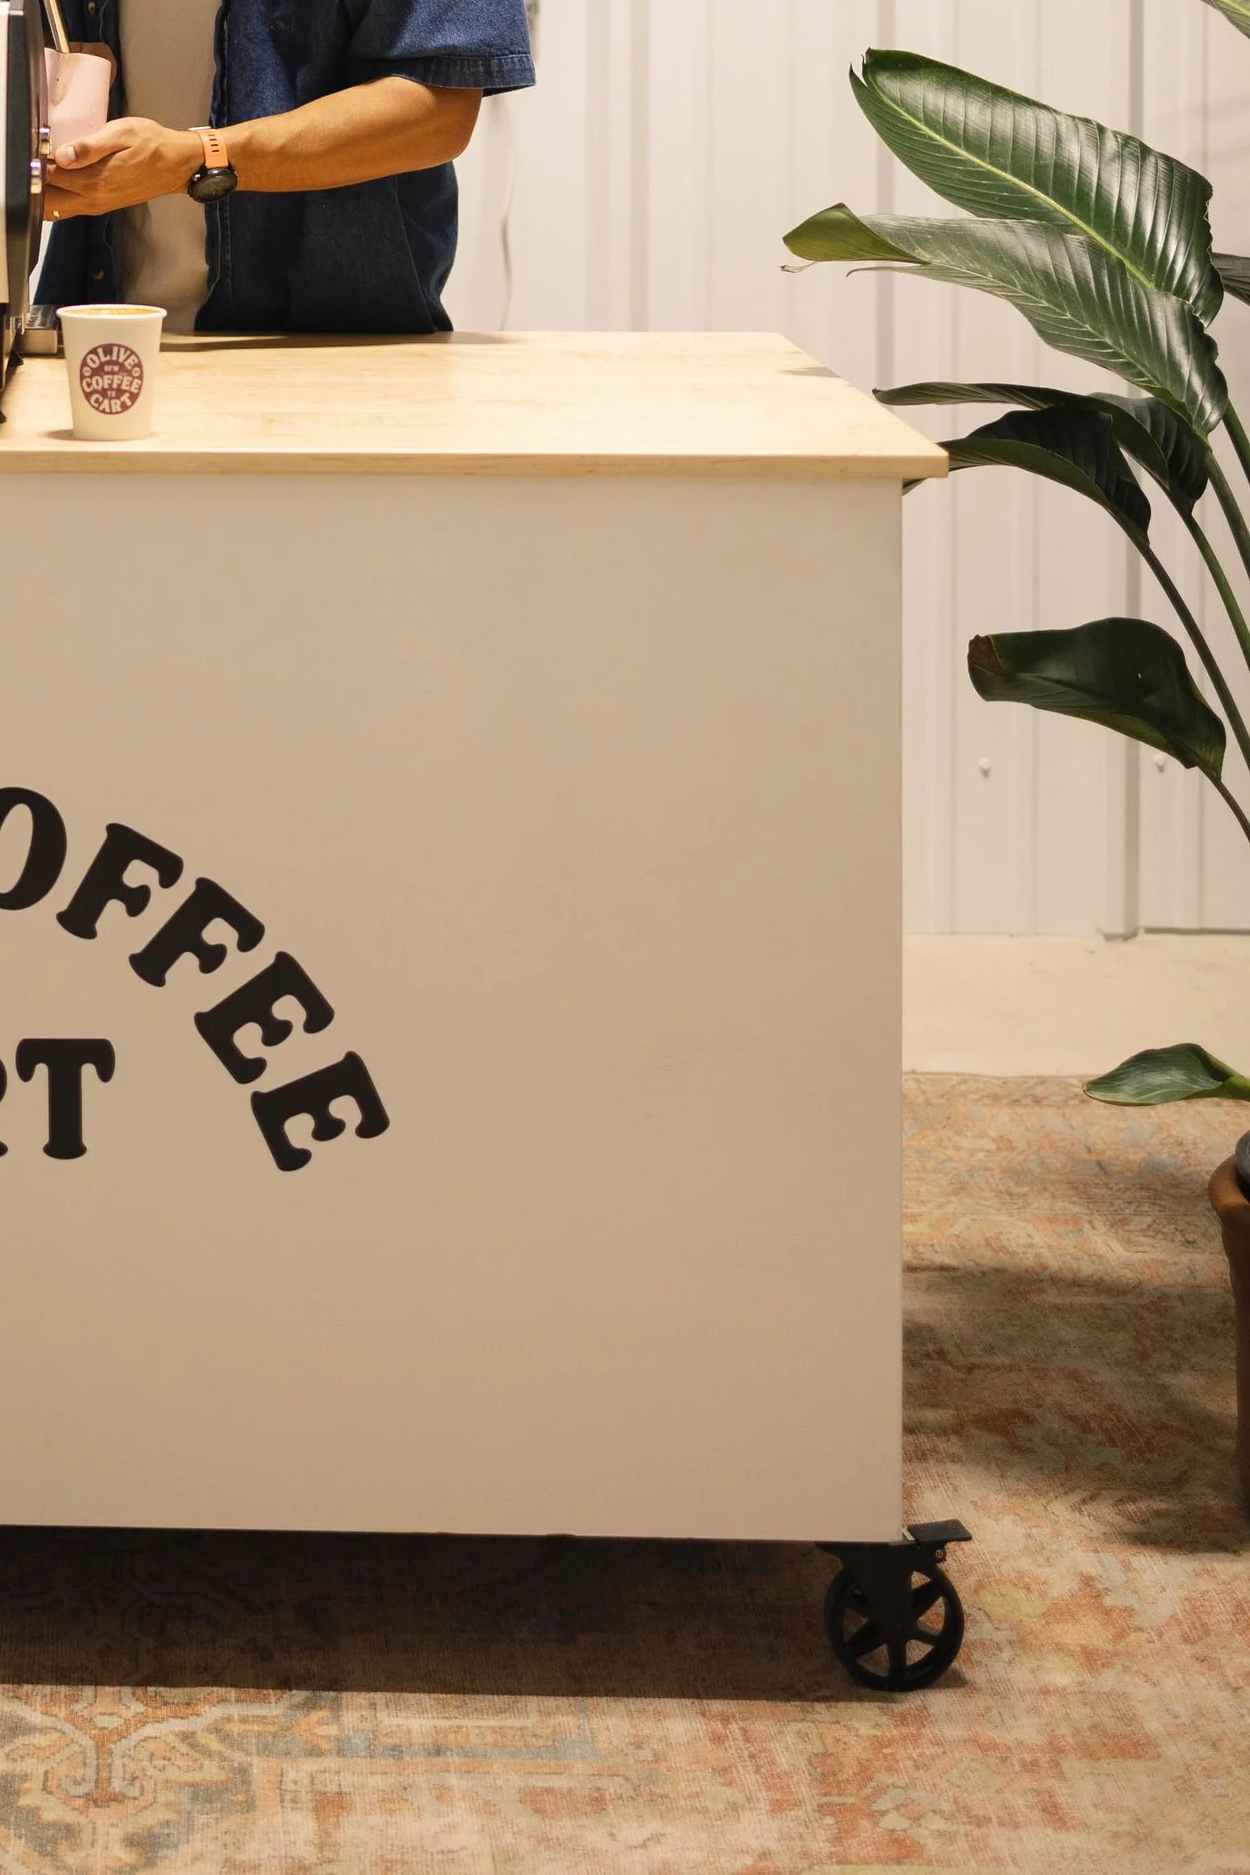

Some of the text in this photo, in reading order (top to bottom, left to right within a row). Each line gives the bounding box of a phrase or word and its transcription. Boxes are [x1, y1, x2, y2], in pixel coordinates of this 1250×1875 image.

[85, 345, 139, 370] OLIVE
[81, 374, 142, 394] COFFEE
[90, 392, 132, 413] CART
